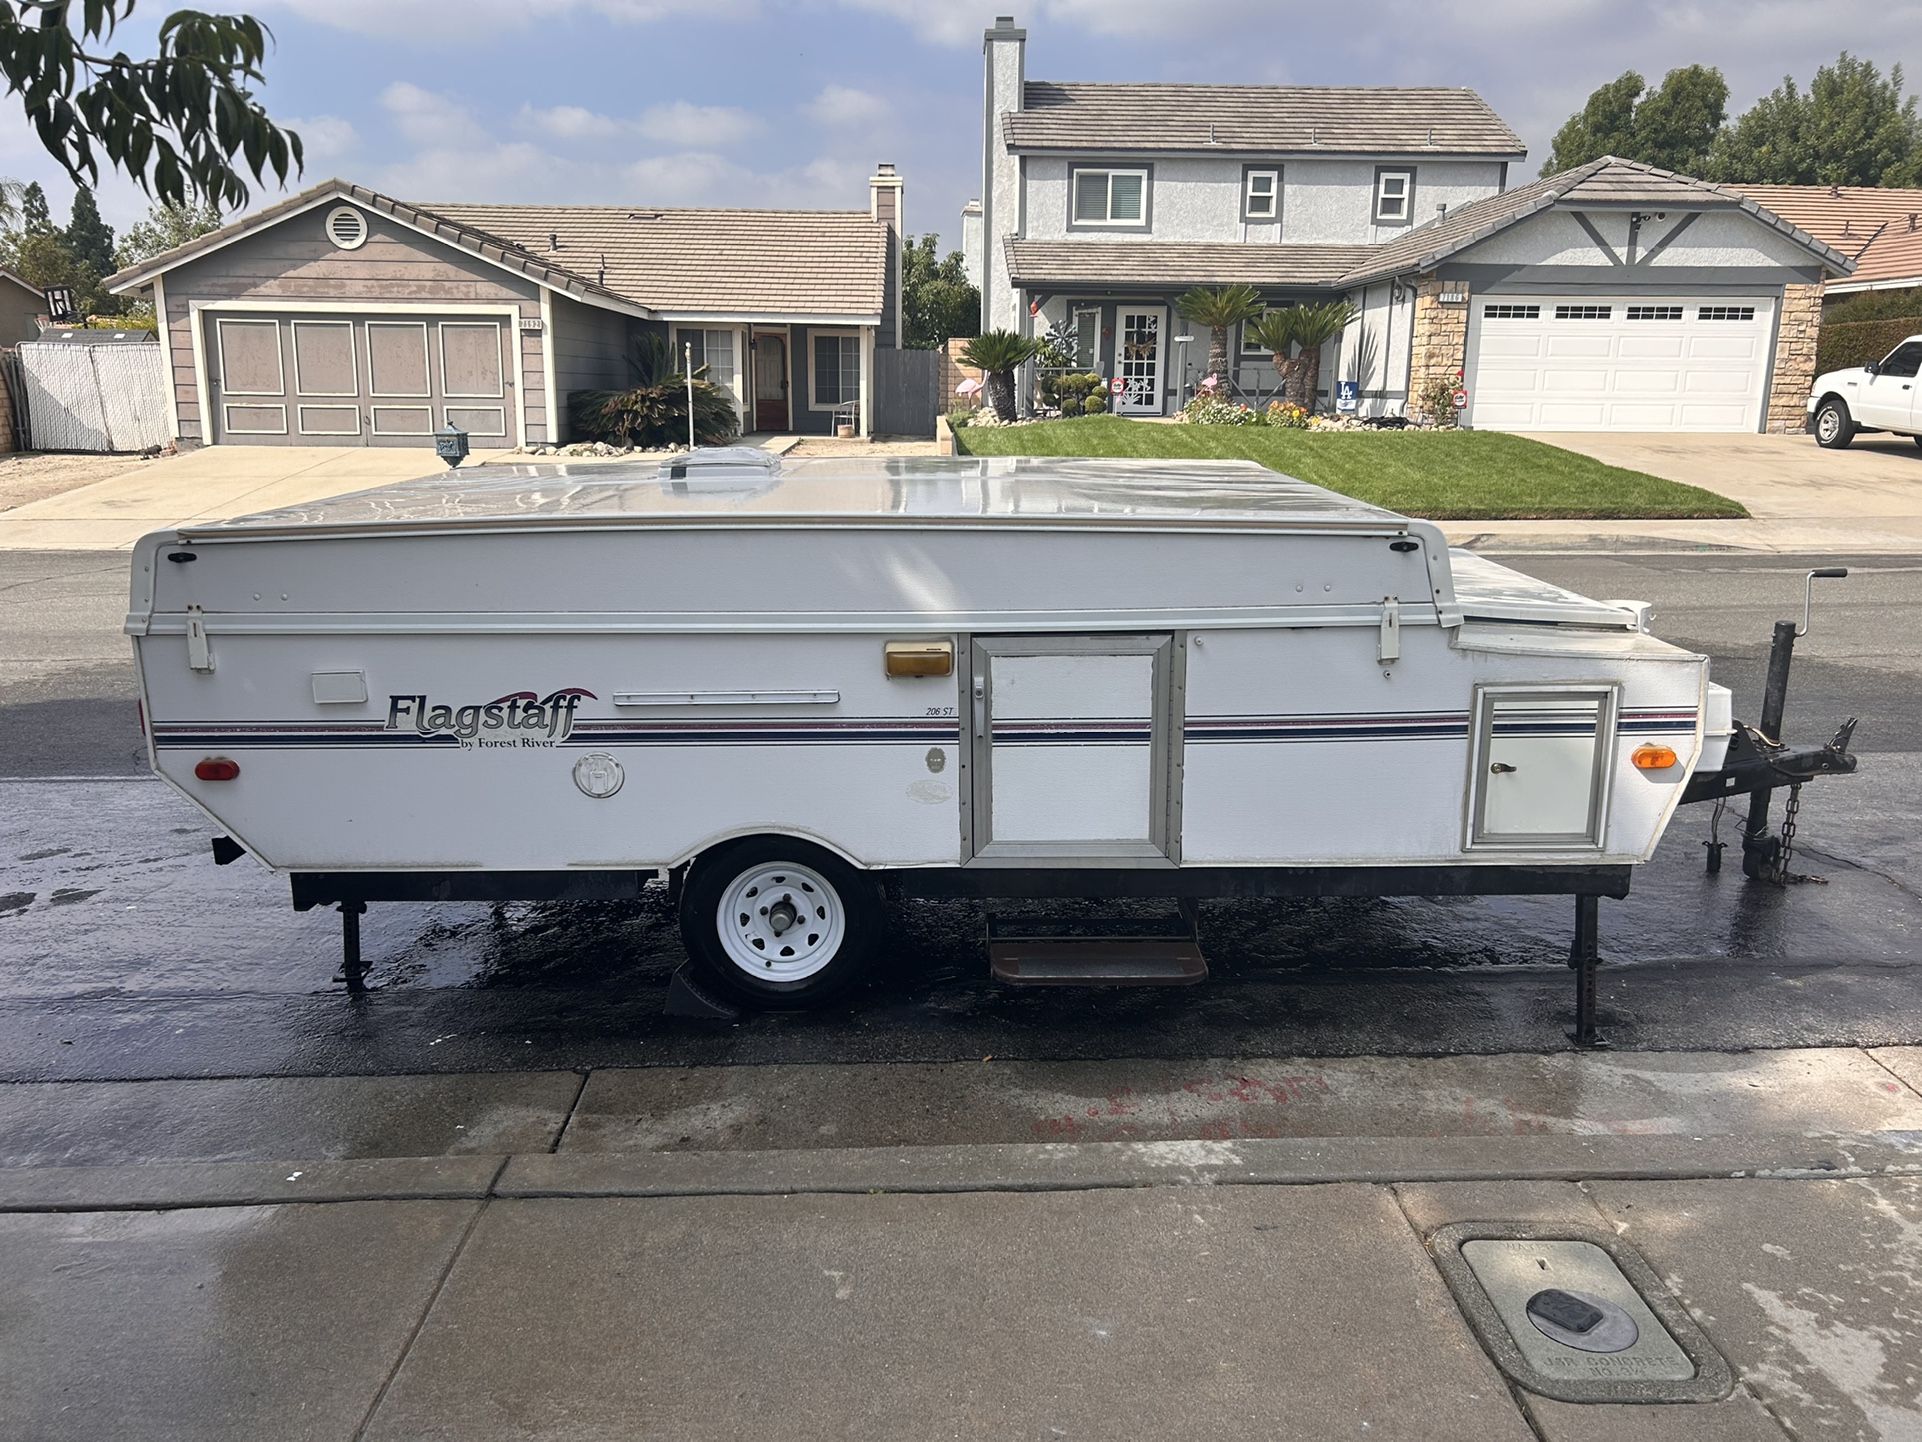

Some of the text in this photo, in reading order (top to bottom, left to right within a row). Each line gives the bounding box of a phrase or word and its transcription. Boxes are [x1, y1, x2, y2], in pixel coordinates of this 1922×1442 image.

[1341, 381, 1352, 399] LA
[386, 693, 582, 739] Flagstaff
[926, 707, 954, 716] 206 ST
[460, 737, 556, 751] by Forest River
